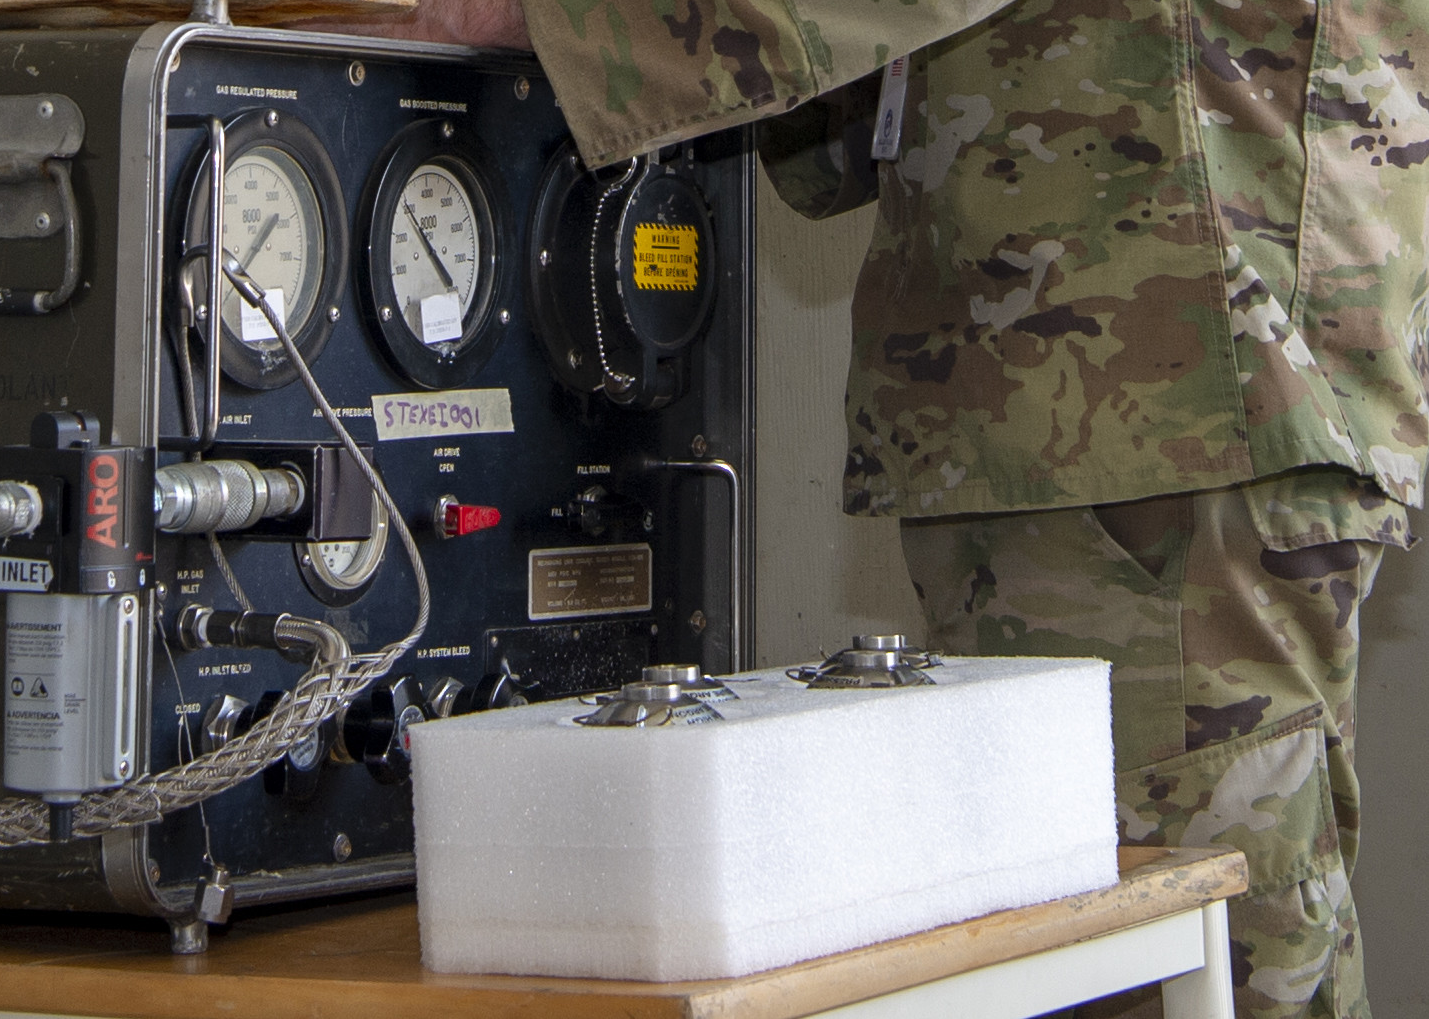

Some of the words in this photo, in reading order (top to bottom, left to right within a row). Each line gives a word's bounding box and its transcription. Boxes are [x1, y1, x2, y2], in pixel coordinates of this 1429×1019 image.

[216, 85, 229, 94] GAS
[230, 86, 265, 98] REGULATED
[266, 88, 298, 100] PRESSURE
[399, 98, 411, 108] GAS
[412, 99, 438, 110] BOOSTED
[438, 101, 467, 112] PRESSURE
[244, 181, 258, 191] 4000
[265, 191, 280, 202] 5000
[421, 188, 434, 199] 4000
[440, 197, 453, 208] 5000
[420, 214, 438, 230] 8000
[652, 234, 680, 245] WARNING
[639, 252, 656, 263] BLEED
[657, 253, 669, 264] FILL
[669, 254, 693, 265] STATION
[665, 266, 689, 278] OPENING
[342, 407, 373, 418] PRESSURE
[222, 414, 233, 425] AIR
[234, 414, 252, 424] INLET
[433, 448, 443, 458] AIR
[443, 447, 460, 457] DRIVE
[439, 463, 455, 473] OPEN
[577, 465, 589, 475] FILL
[589, 464, 611, 475] STATION
[86, 454, 120, 548] ARO
[551, 507, 563, 518] FILL
[1, 560, 49, 584] INLET
[191, 570, 204, 580] GAS
[181, 584, 200, 595] INLET
[429, 647, 451, 659] SYSTEM
[452, 646, 471, 657] BLEED
[212, 665, 230, 676] INLET
[230, 663, 252, 674] BLEED
[174, 702, 202, 715] CLOSED
[12, 711, 61, 721] ADVERTENCIA
